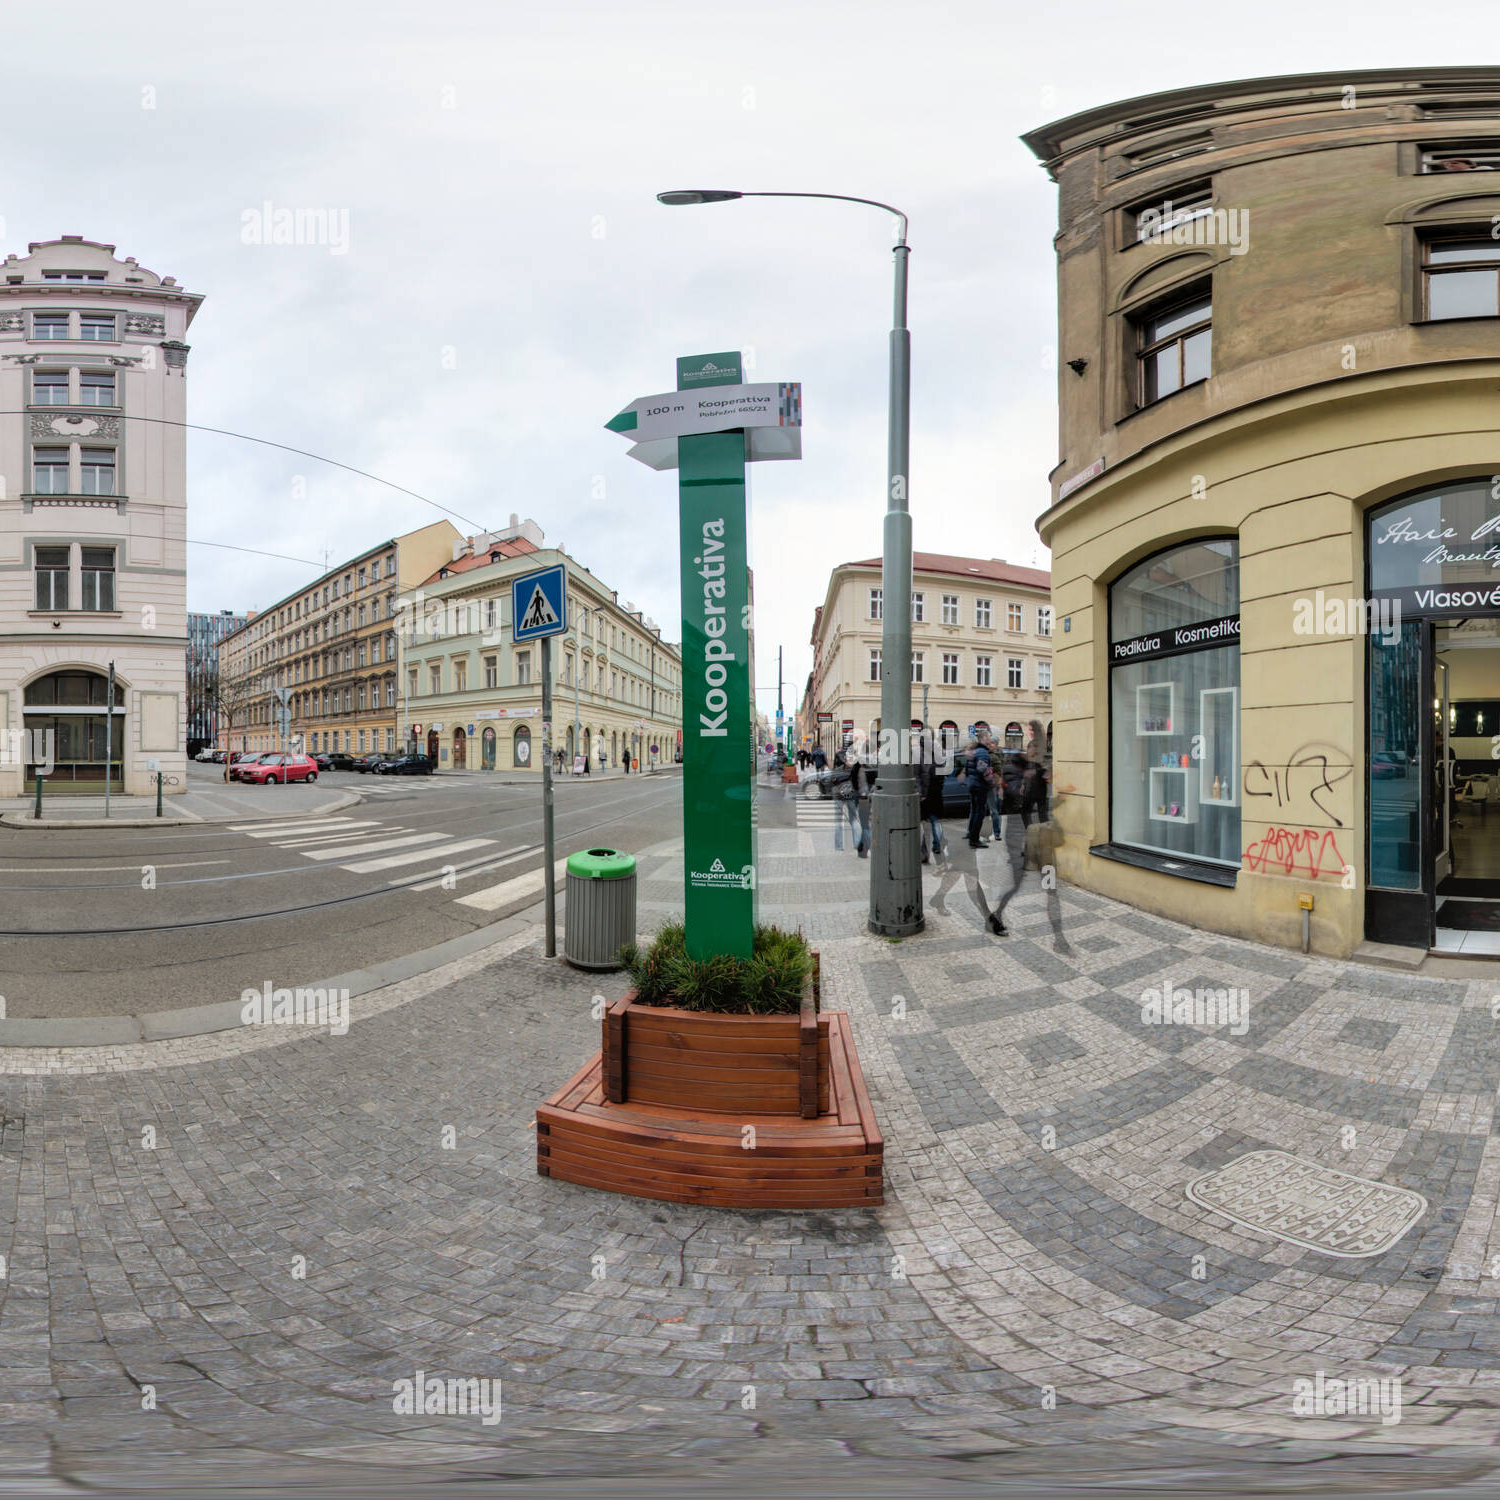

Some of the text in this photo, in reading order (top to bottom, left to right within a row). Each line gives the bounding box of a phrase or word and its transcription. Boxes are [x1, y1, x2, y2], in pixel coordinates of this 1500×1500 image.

[646, 406, 670, 416] 100
[698, 396, 771, 408] Kooperativa
[1377, 517, 1458, 544] Hair
[698, 518, 735, 737] Kooperativa
[1114, 637, 1161, 658] Pedikúra
[691, 871, 745, 881] Kooperativa
